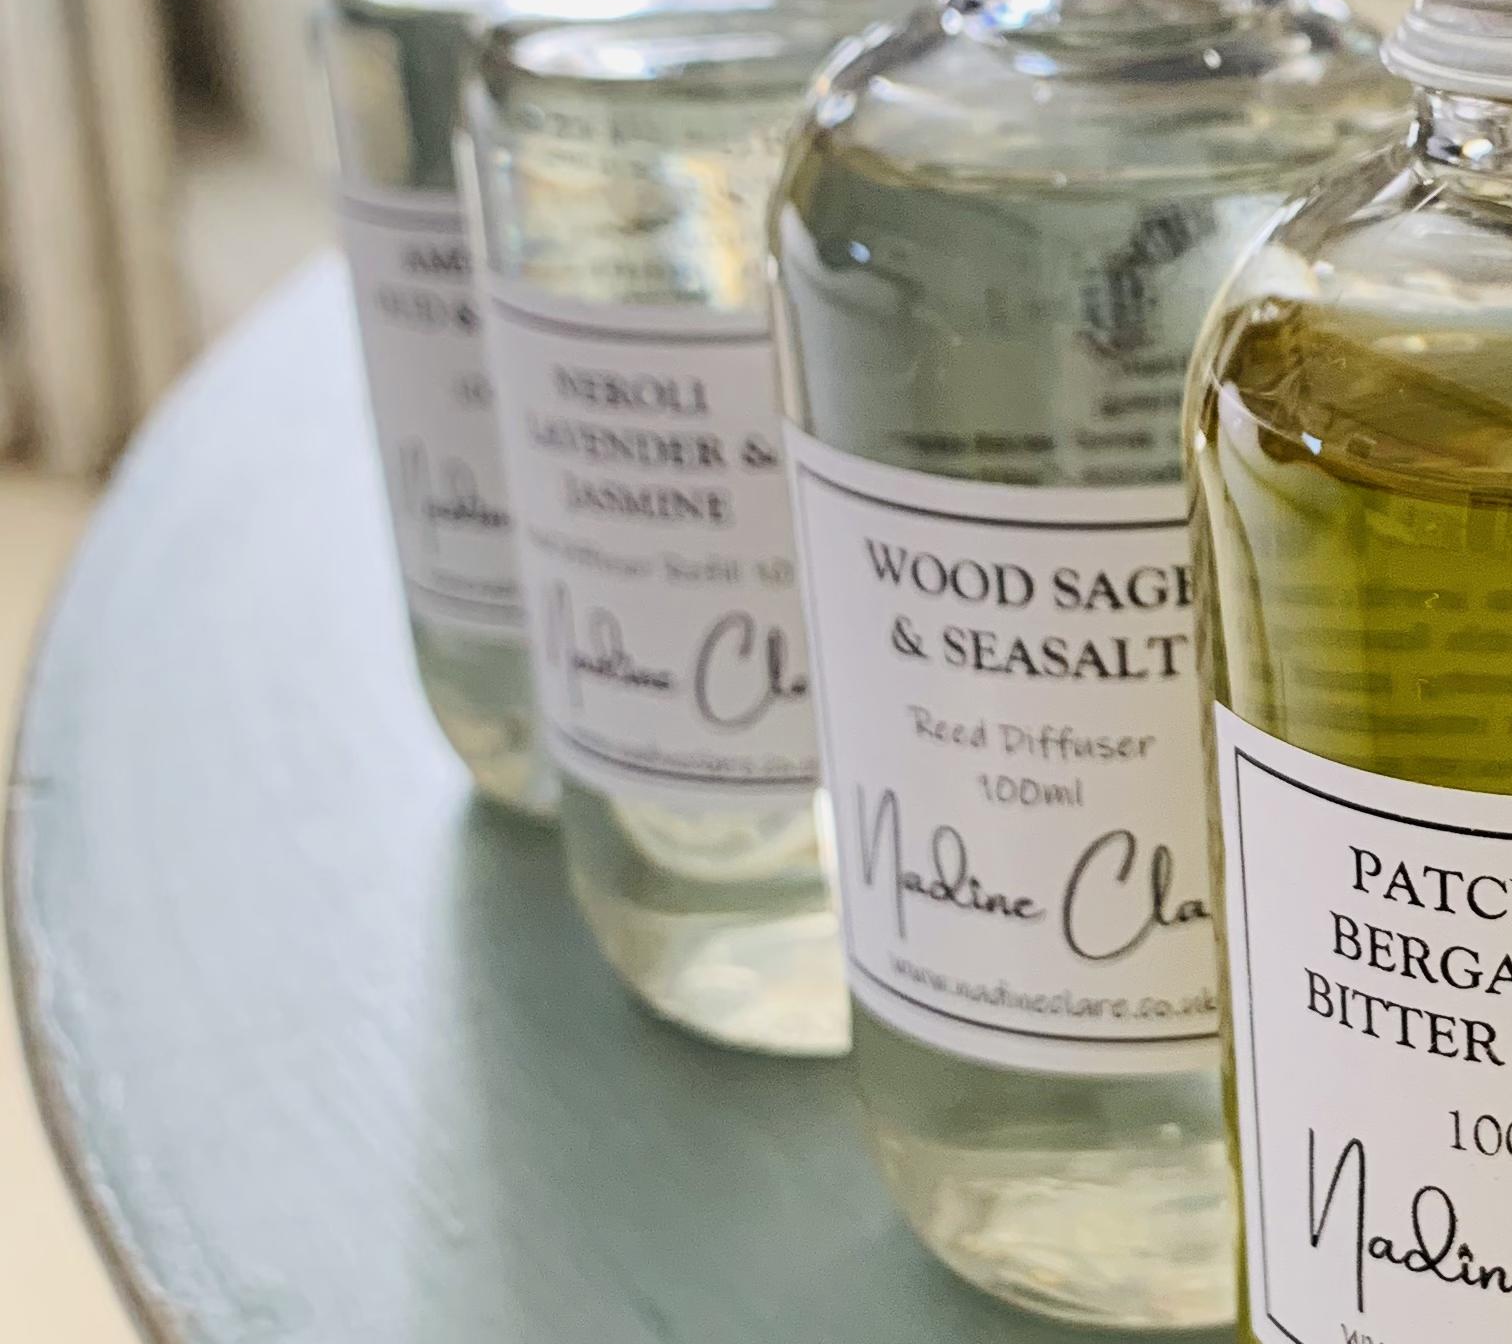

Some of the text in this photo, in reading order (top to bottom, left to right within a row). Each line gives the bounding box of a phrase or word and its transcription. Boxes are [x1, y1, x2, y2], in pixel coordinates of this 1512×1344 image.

[740, 433, 777, 470] &
[865, 536, 1034, 609] WOOD
[891, 614, 1189, 681] & SEASALT
[906, 704, 1156, 760] Reed Diffuser
[975, 773, 1084, 809] 100ml
[855, 782, 1046, 938] Nadine
[1303, 968, 1505, 1067] BITTER
